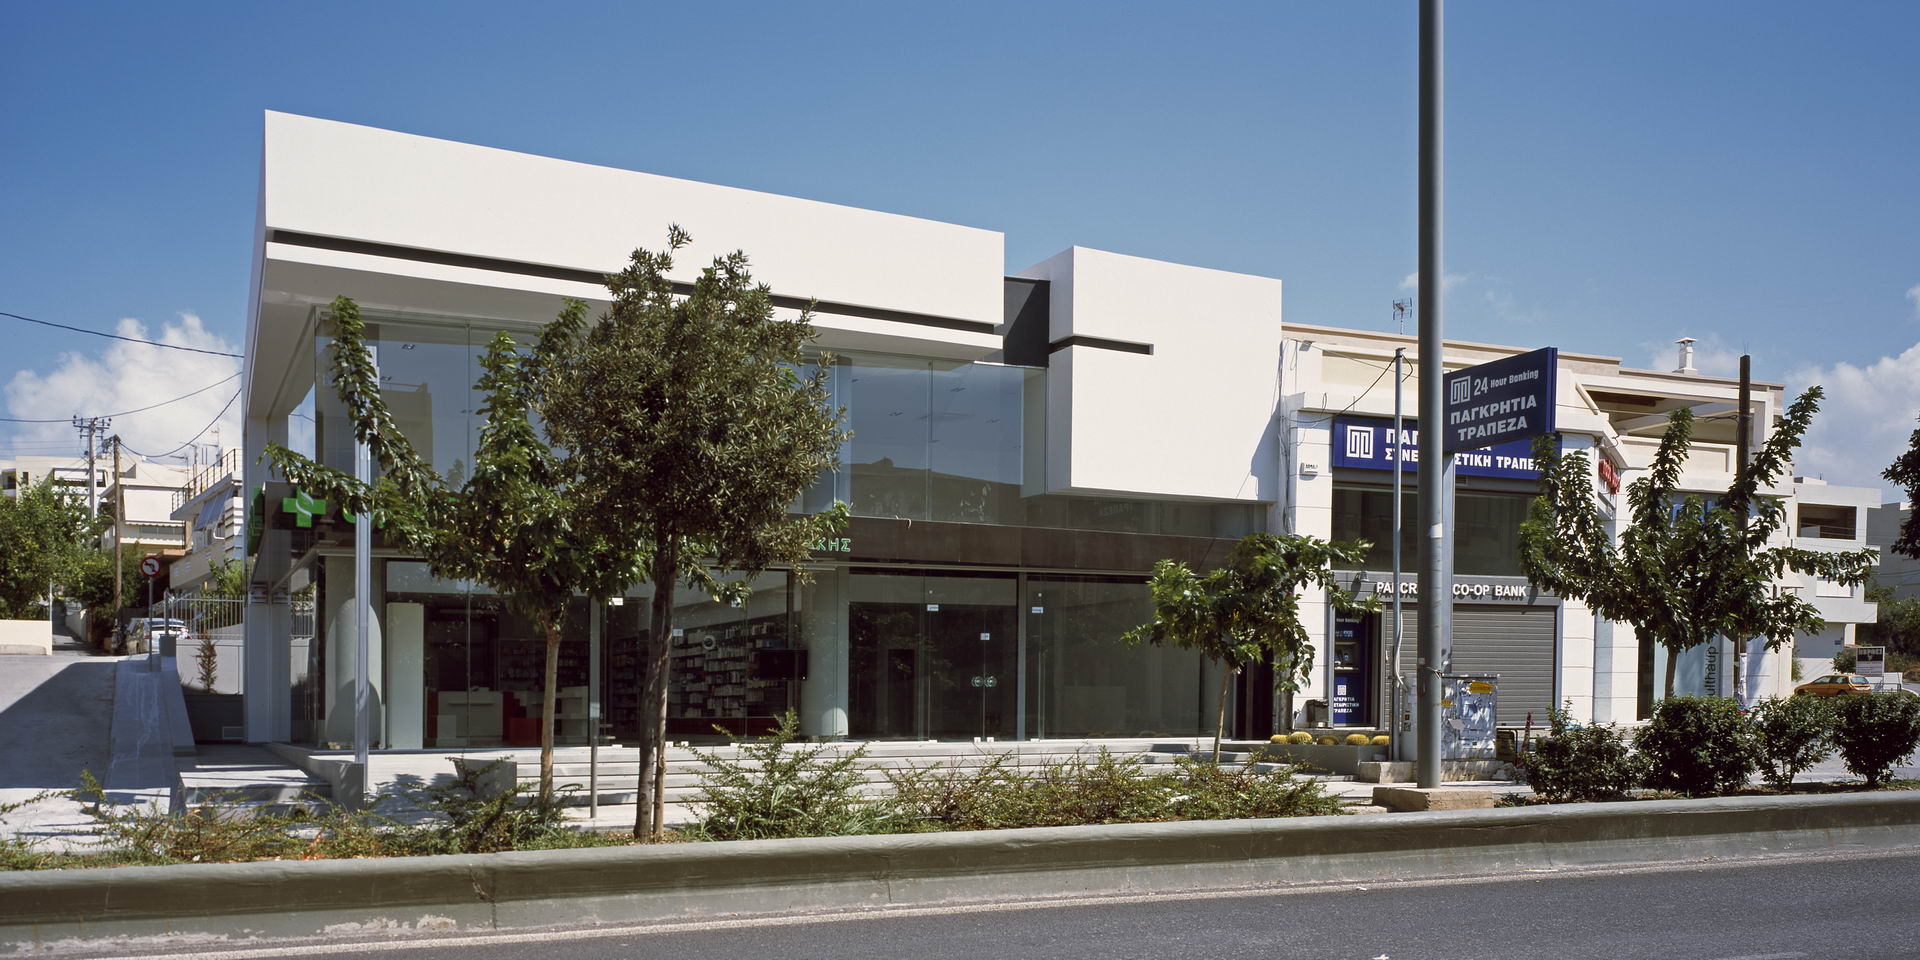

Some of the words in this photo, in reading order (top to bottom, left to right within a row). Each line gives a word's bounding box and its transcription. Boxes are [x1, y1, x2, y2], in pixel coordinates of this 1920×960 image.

[1474, 377, 1488, 396] 24
[1490, 378, 1507, 388] Hour
[1509, 370, 1539, 384] Banking
[1450, 395, 1537, 425] ΠΑΓΚΡΗΤΙΑ
[1458, 416, 1527, 441] ΤΡΑΠΕΖΑ
[1496, 456, 1544, 471] ΤΡΑΠΕ
[814, 537, 851, 553] ΚΗΣ
[1453, 584, 1490, 596] CO-OP
[1495, 585, 1527, 597] BANK
[1704, 646, 1719, 697] ulthaup
